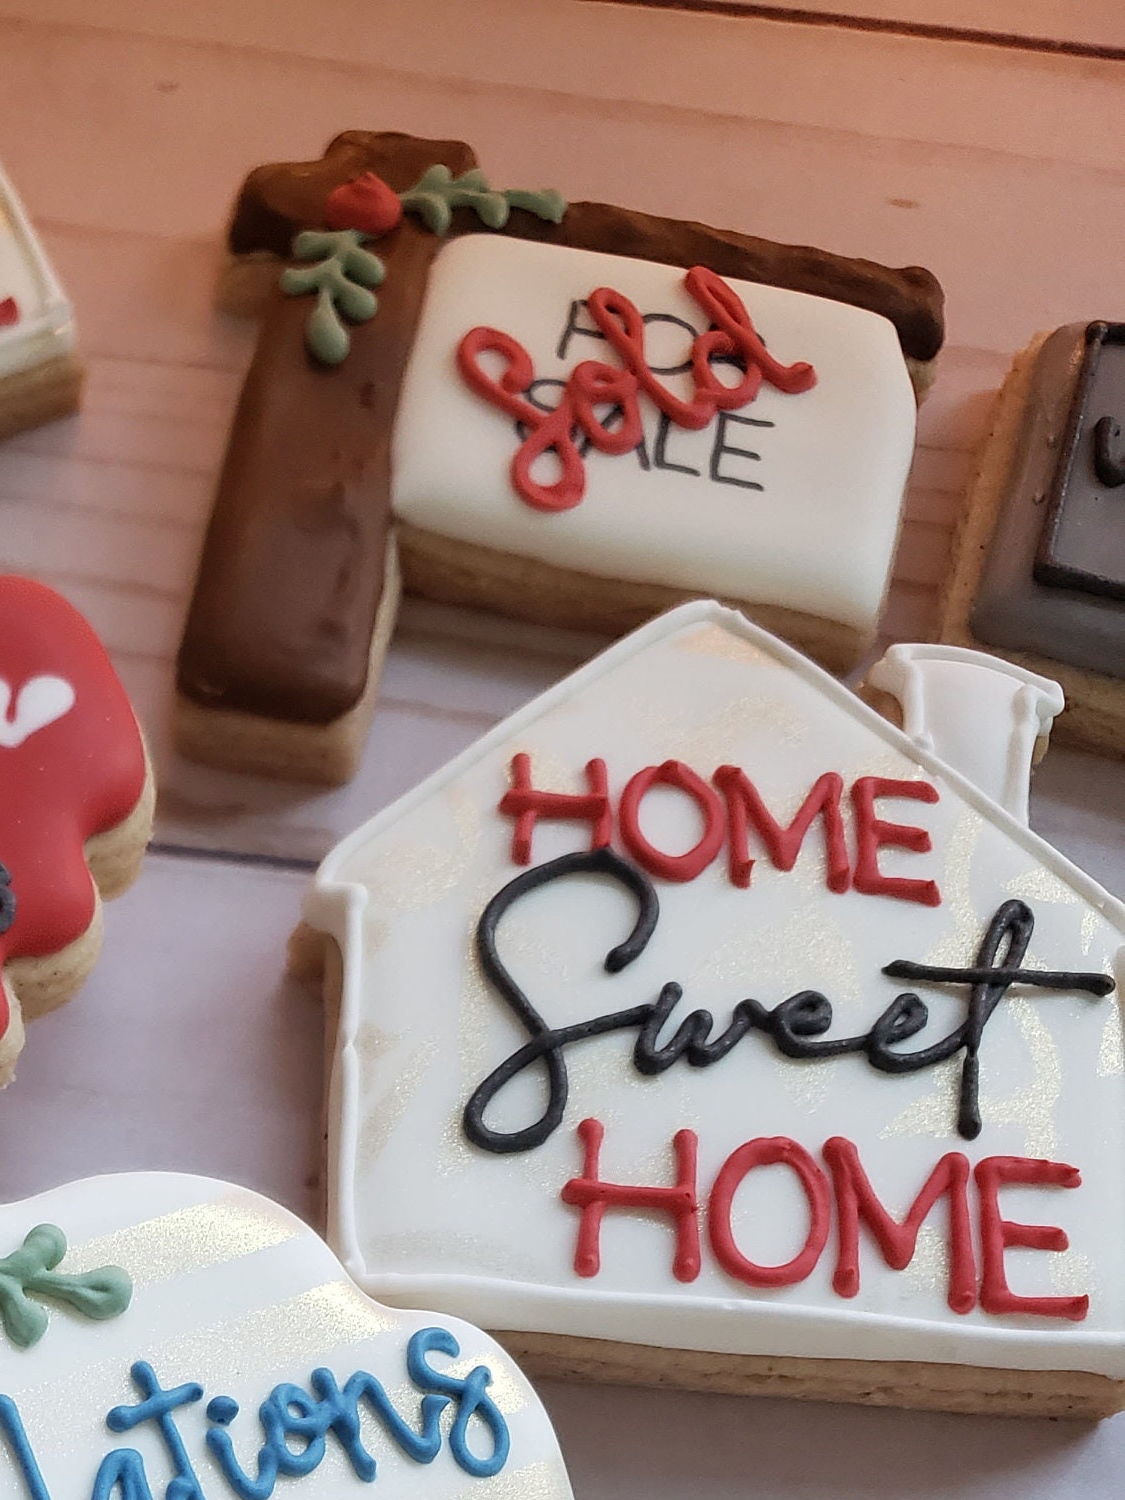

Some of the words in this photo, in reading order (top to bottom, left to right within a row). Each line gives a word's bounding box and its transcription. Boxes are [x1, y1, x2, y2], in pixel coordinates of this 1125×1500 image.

[498, 752, 942, 908] HOME
[463, 847, 1116, 1154] Sweet
[561, 1117, 1090, 1321] HOME
